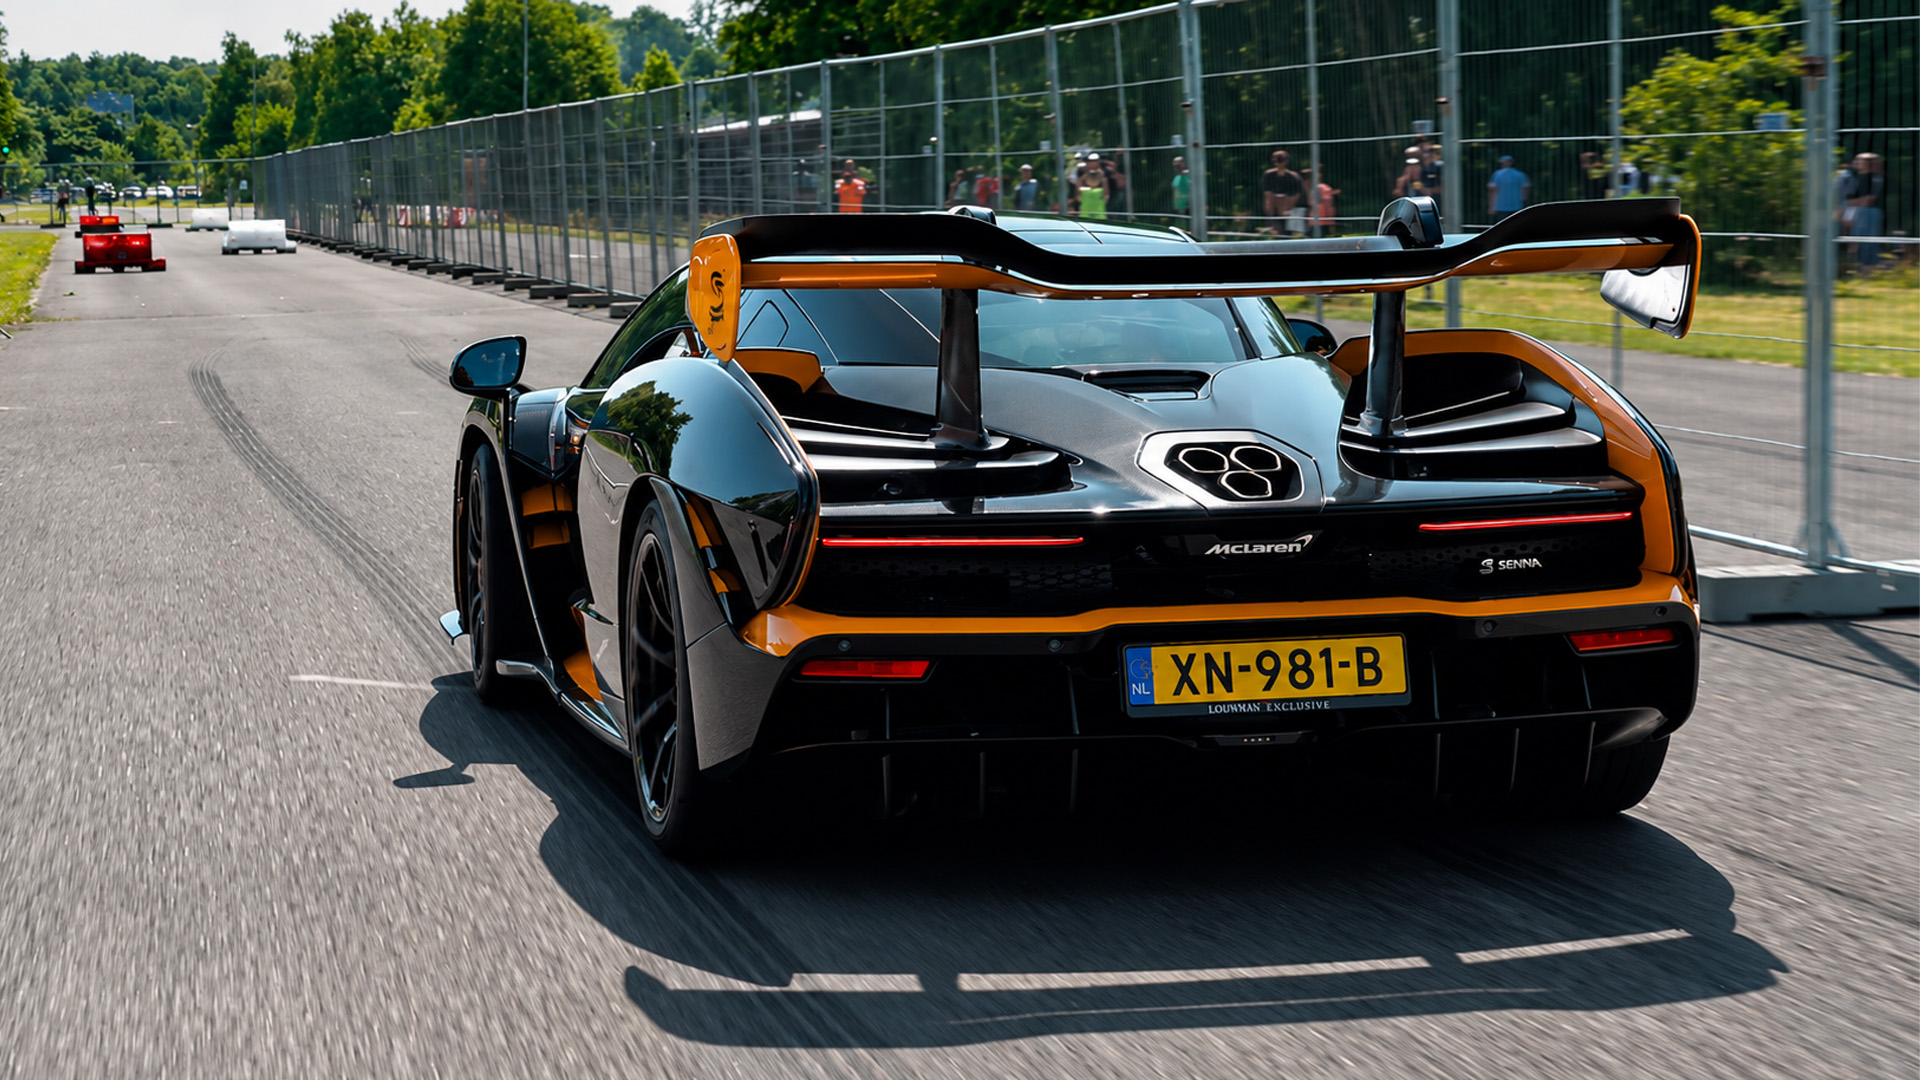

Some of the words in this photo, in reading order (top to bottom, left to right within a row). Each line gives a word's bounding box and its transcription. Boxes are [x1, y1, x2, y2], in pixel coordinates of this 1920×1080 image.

[1204, 543, 1302, 555] McLaren
[1498, 558, 1543, 570] SENNA
[1170, 646, 1383, 696] XN-981-B
[1132, 683, 1151, 695] NL
[1266, 700, 1331, 712] EXCLUSIVE
